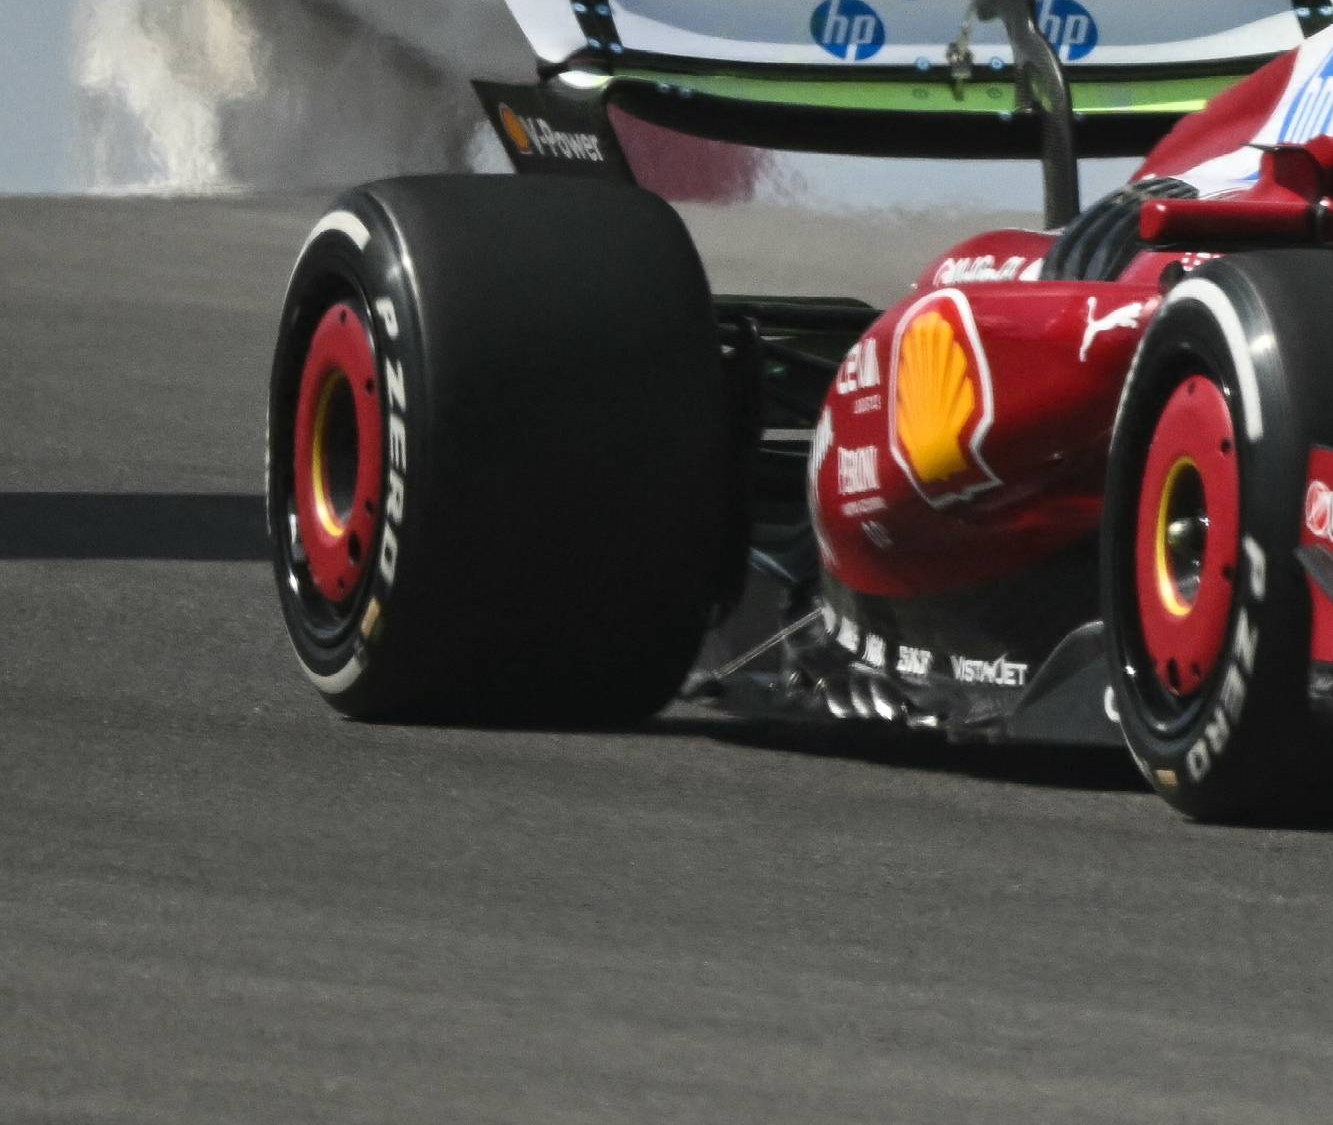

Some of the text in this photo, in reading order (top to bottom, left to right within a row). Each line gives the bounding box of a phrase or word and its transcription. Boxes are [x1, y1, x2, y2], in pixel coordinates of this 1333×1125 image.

[519, 116, 604, 162] V-Power
[376, 297, 407, 587] P ZERO
